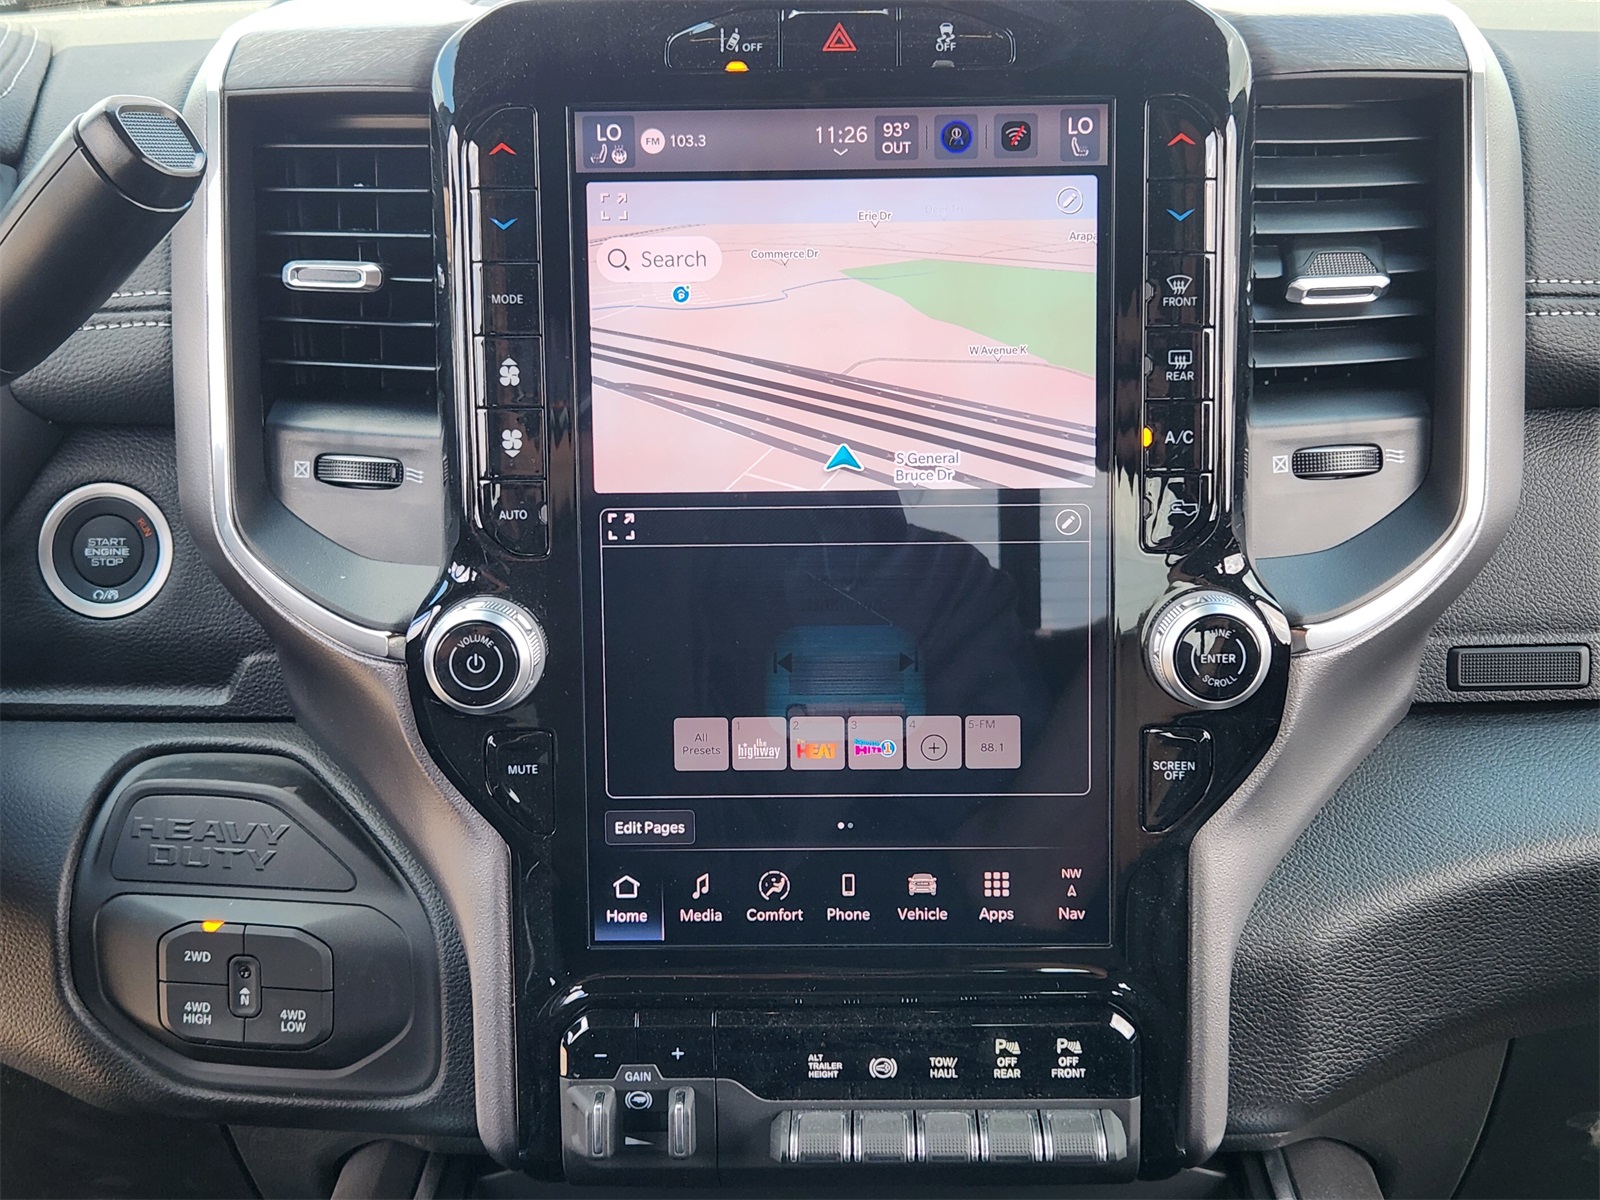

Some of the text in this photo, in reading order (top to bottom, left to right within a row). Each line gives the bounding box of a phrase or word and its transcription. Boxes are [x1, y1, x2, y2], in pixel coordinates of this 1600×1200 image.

[742, 43, 763, 53] OFF
[935, 42, 957, 52] OFF
[882, 122, 910, 138] 93°
[1067, 116, 1094, 135] LO
[596, 123, 622, 141] LO
[815, 126, 868, 146] 11:26
[645, 136, 661, 147] FM
[669, 134, 707, 148] 103.3
[881, 141, 911, 155] OUT
[858, 210, 892, 222] Erie Dr
[641, 249, 707, 268] Search
[750, 247, 820, 260] Commerce Dr
[491, 294, 524, 305] MODE
[1162, 296, 1198, 307] FRONT
[969, 345, 1028, 355] W Avenue K
[1165, 371, 1194, 381] REAR
[1164, 430, 1194, 444] A/C
[896, 452, 959, 465] S General
[896, 469, 954, 482] Bruce Dr
[499, 509, 528, 520] AUTO
[136, 517, 153, 538] RUN
[88, 537, 127, 546] START
[84, 547, 130, 557] ENGINE
[91, 558, 124, 567] STOP
[456, 634, 496, 650] VOLUME
[1200, 653, 1237, 664] ENTER
[1202, 674, 1238, 688] SCROLL
[792, 720, 799, 731] 2
[850, 720, 858, 730] 3
[908, 719, 916, 730] 4
[968, 719, 996, 730] 5-FM
[694, 732, 708, 743] All
[756, 738, 768, 749] the
[682, 745, 721, 756] Presets
[737, 743, 781, 760] highway
[796, 743, 838, 759] HEAT
[980, 742, 1005, 753] 88.1
[507, 764, 539, 775] MUTE
[1152, 760, 1196, 771] SCREEN
[1163, 771, 1186, 781] OFF
[131, 816, 290, 846] HEAVY
[614, 821, 686, 836] Edit Pages
[148, 844, 277, 871] DUTY
[1061, 868, 1083, 879] NW
[606, 909, 648, 924] Home
[679, 908, 723, 923] Media
[746, 907, 804, 922] Comfort
[826, 907, 871, 921] Phone
[897, 907, 948, 921] Vehicle
[978, 907, 1015, 923] Apps
[1058, 906, 1086, 921] Nav
[183, 950, 212, 963] 2WD
[183, 1001, 211, 1013] 4WD
[183, 1013, 212, 1025] HIGH
[279, 1009, 307, 1021] 4WD
[280, 1021, 307, 1033] LOW
[808, 1053, 824, 1062] ALT
[929, 1056, 958, 1068] TOW/
[996, 1056, 1018, 1068] OFF
[1057, 1056, 1079, 1067] OFF
[808, 1061, 843, 1070] TRAILER
[624, 1070, 652, 1083] GAIN
[808, 1070, 839, 1079] HEIGHT
[929, 1068, 959, 1079] HAUL
[993, 1068, 1021, 1079] REAR
[1051, 1067, 1087, 1079] FRONT
